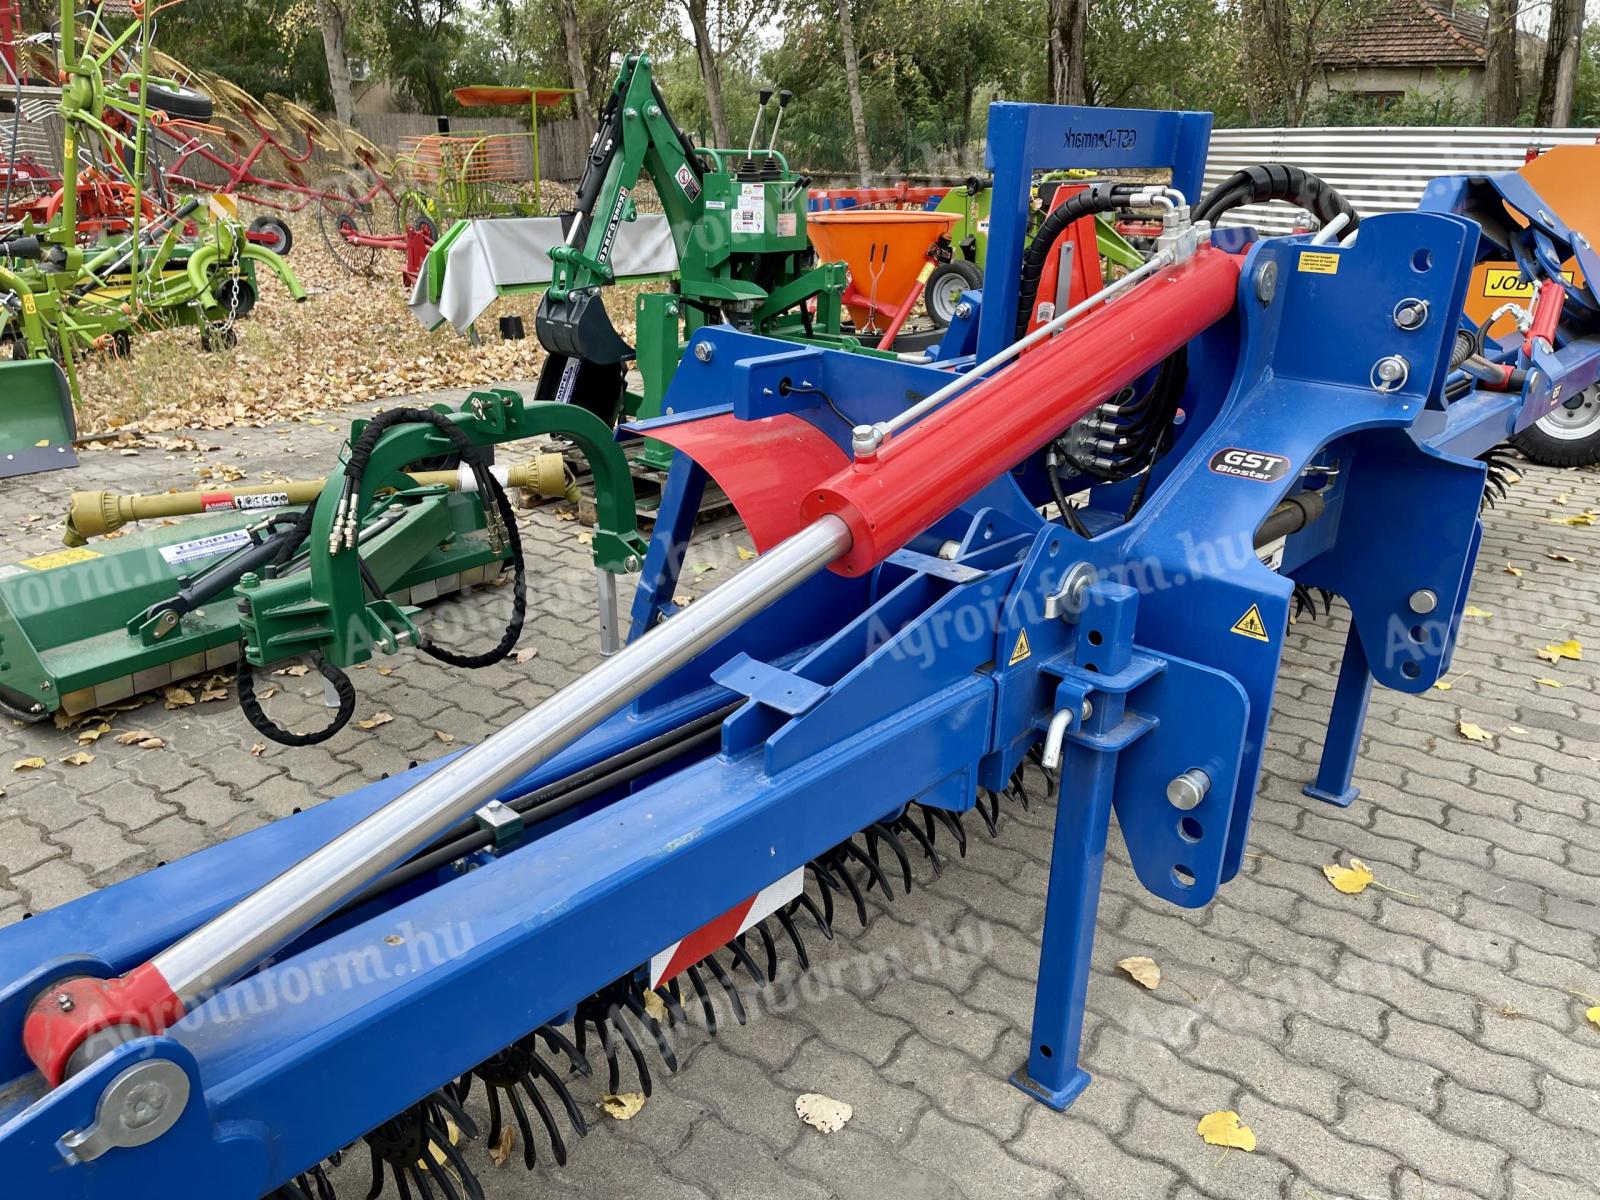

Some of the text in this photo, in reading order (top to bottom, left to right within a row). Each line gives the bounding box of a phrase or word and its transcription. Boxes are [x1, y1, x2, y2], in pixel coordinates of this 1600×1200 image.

[599, 195, 626, 263] KEEP CLEAR
[1224, 450, 1283, 471] GST
[1215, 464, 1272, 480] Biostar
[175, 532, 244, 550] TEMPEL
